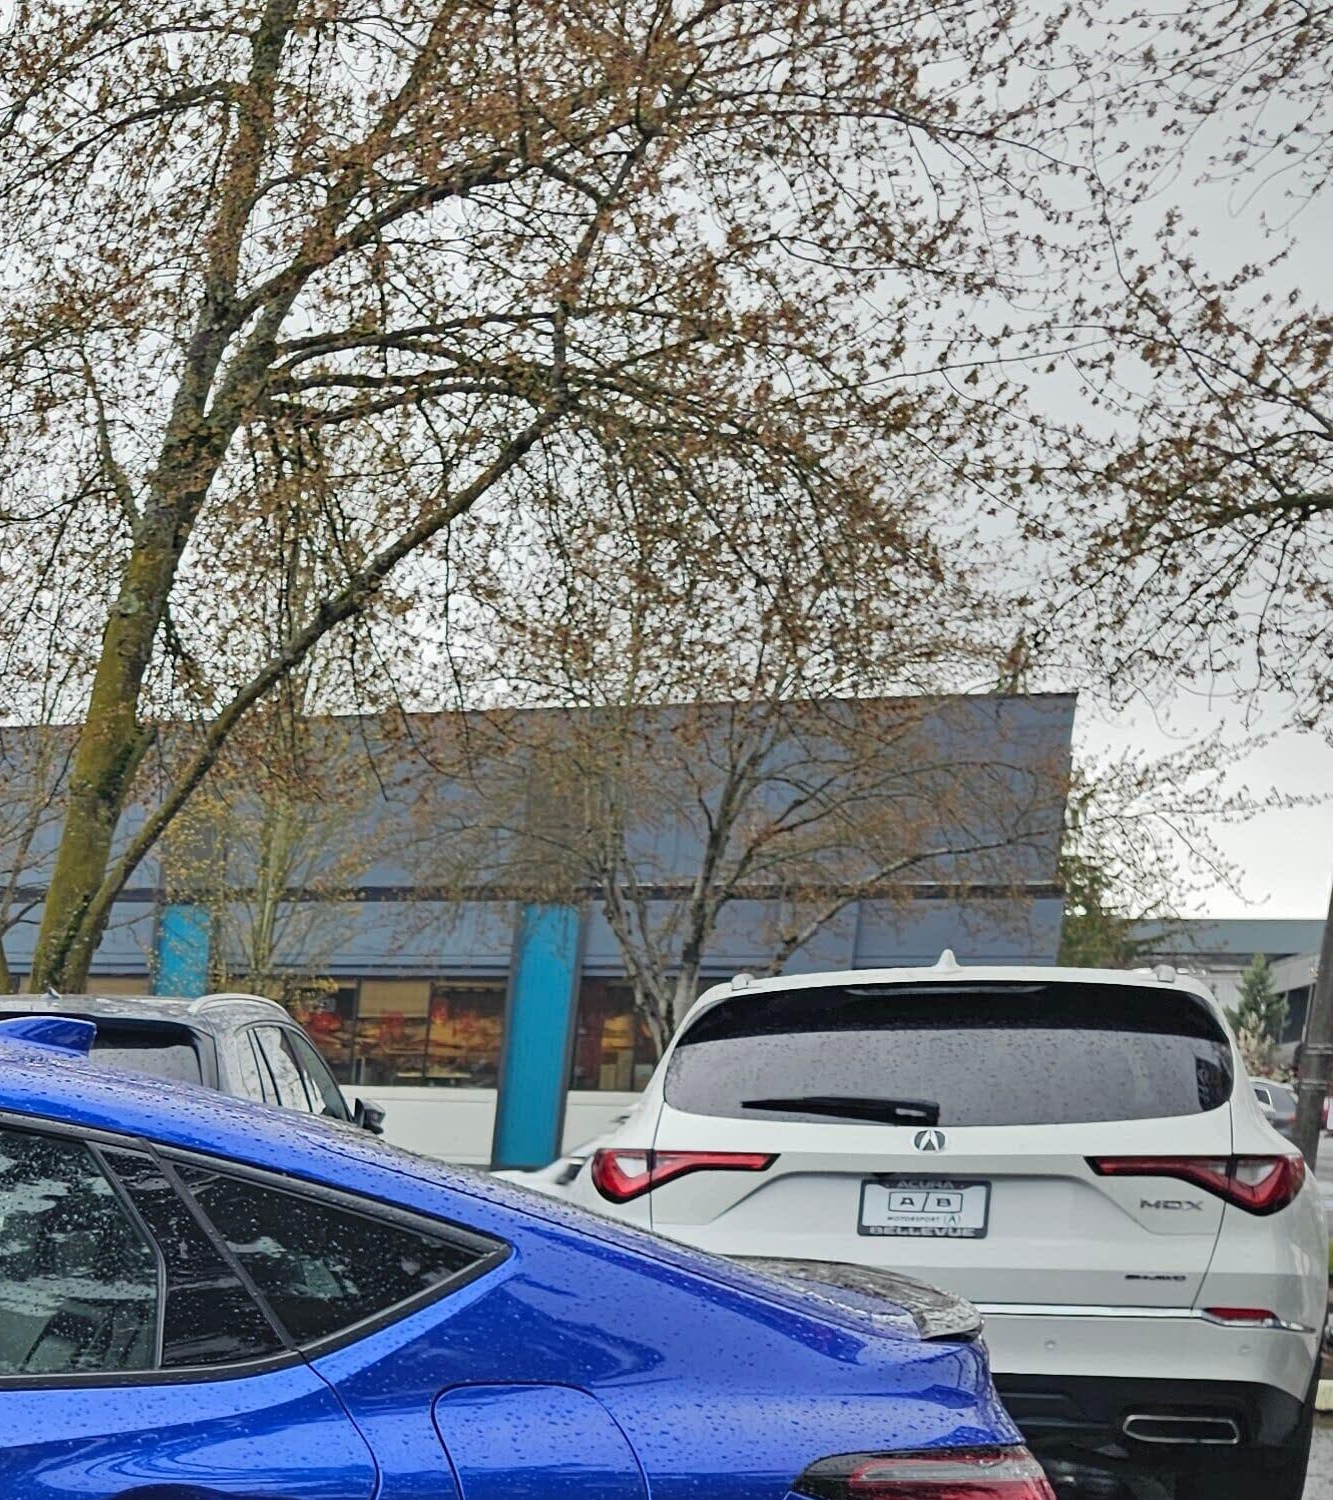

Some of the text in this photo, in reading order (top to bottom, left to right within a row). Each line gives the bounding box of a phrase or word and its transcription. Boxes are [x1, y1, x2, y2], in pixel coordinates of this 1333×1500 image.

[897, 1180, 955, 1190] ACURA
[1139, 1199, 1204, 1211] MDX
[868, 1226, 976, 1237] BELLEVUE
